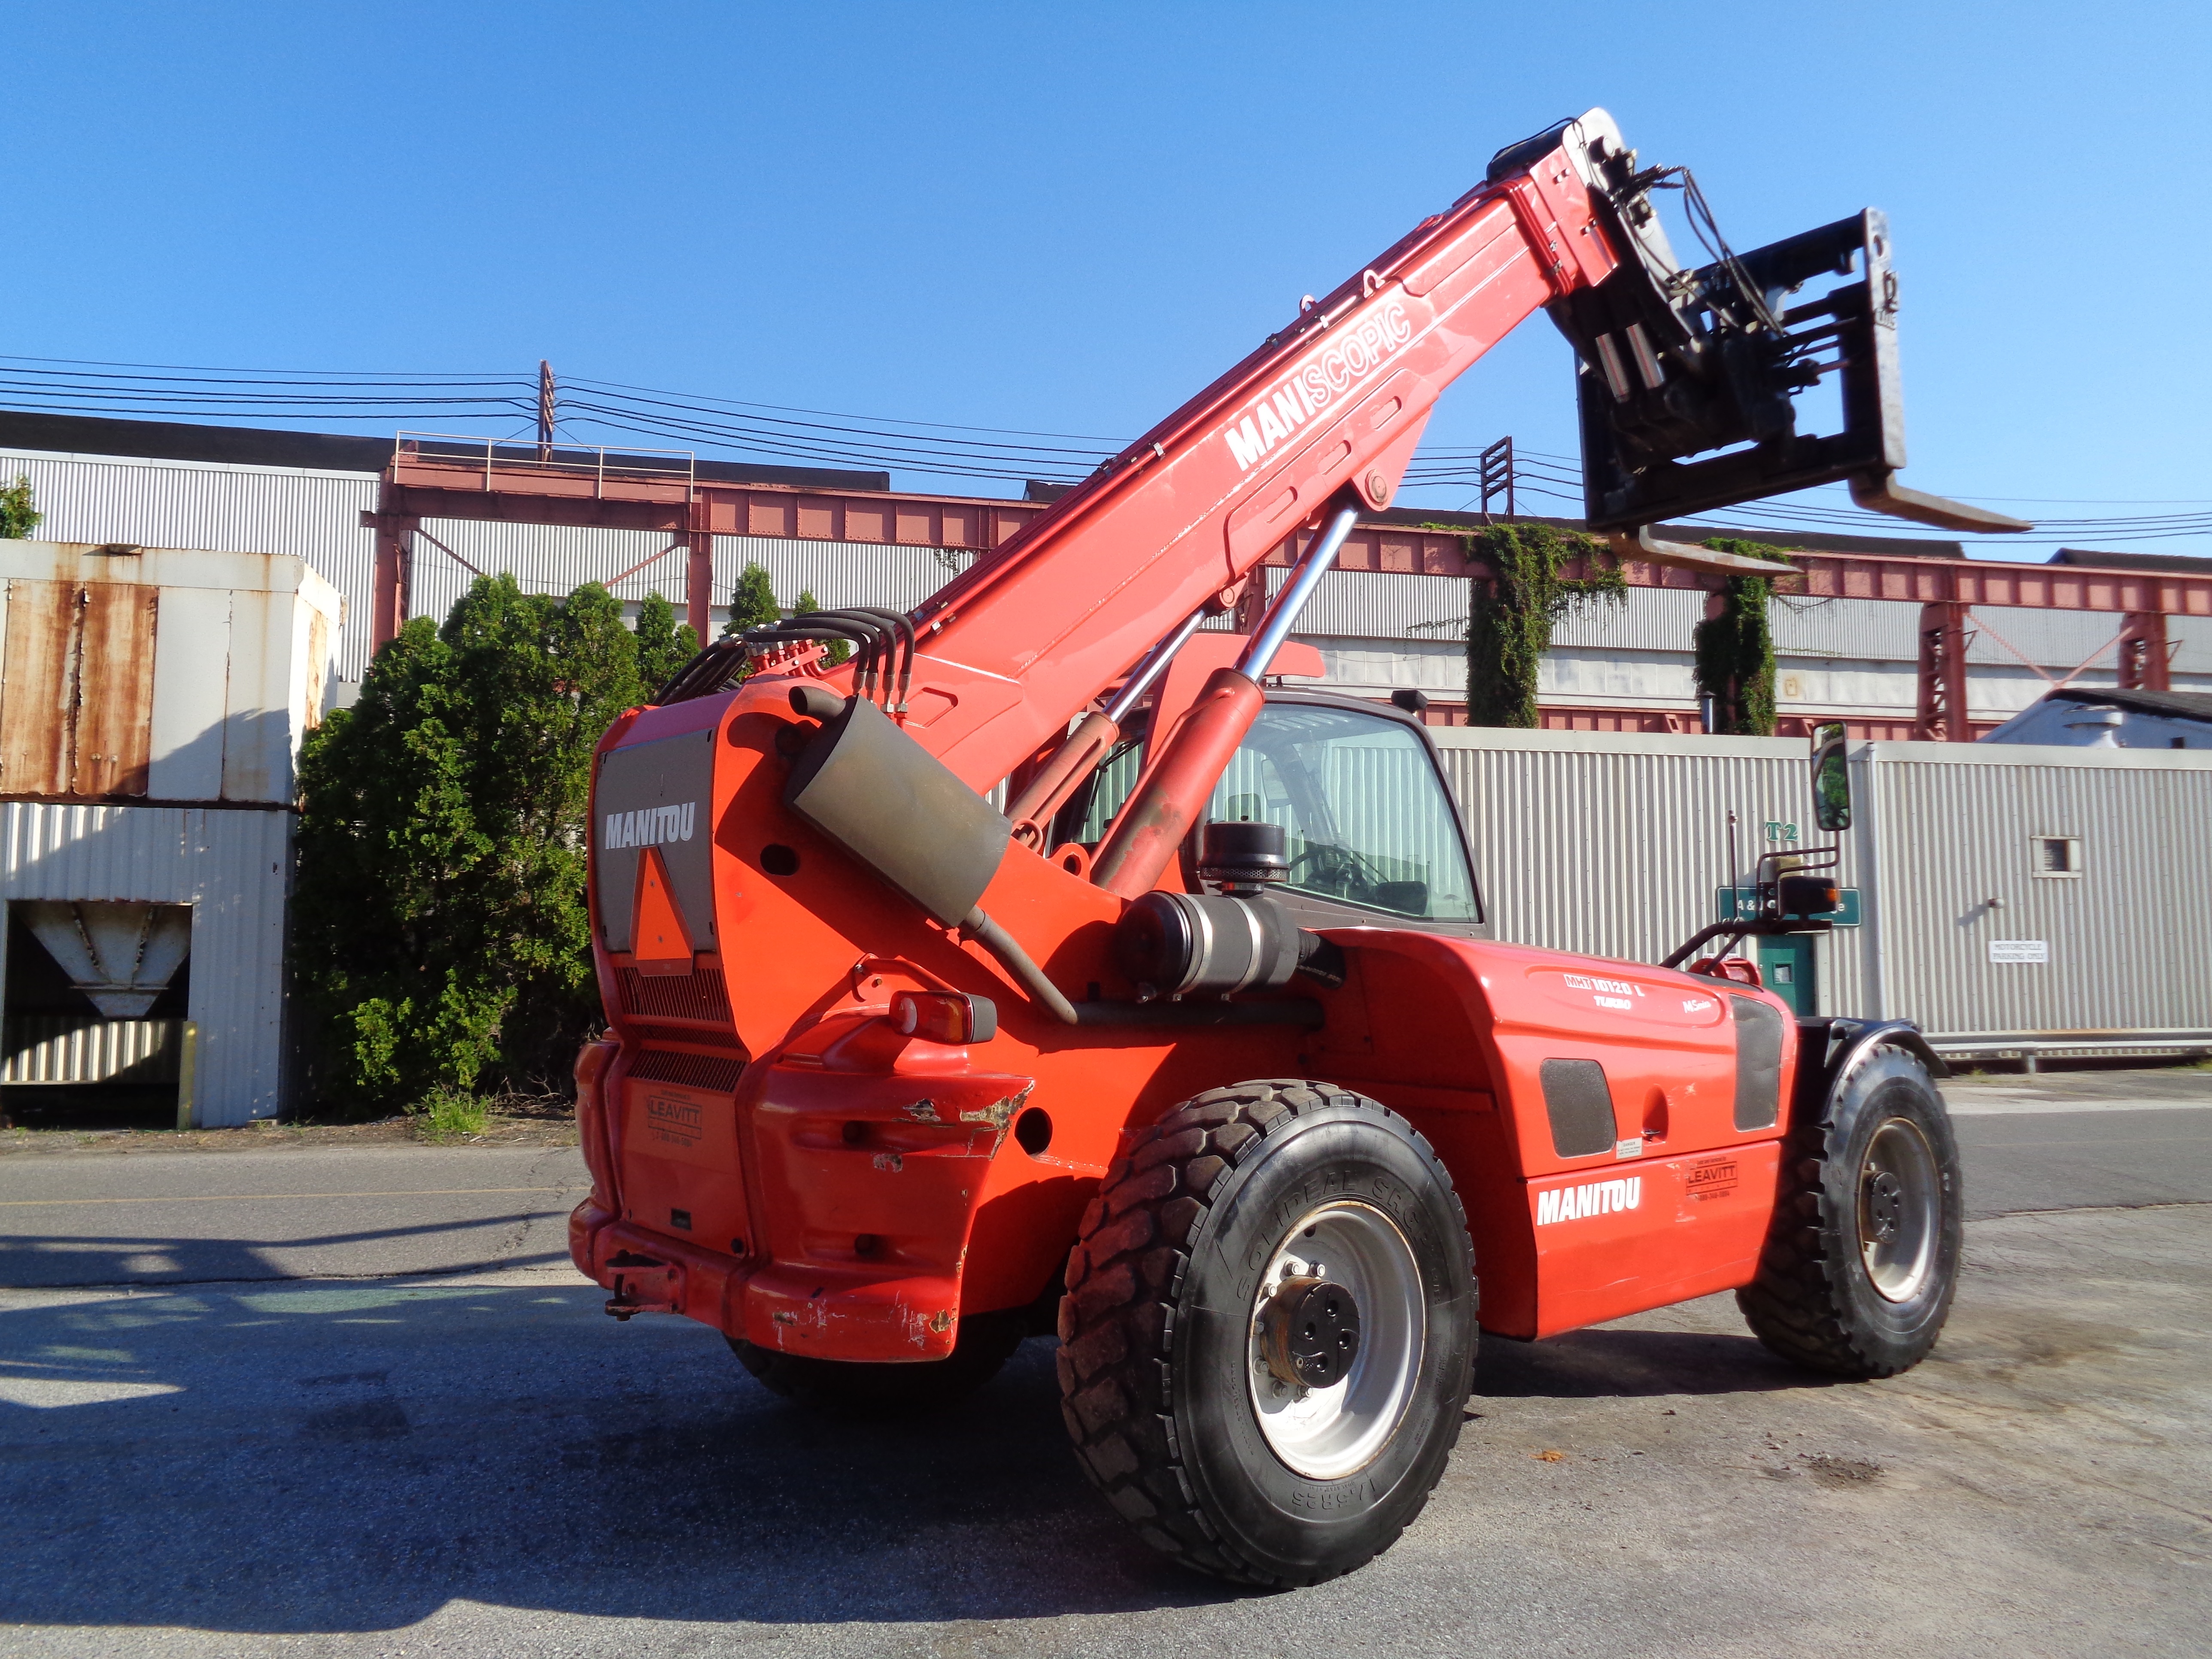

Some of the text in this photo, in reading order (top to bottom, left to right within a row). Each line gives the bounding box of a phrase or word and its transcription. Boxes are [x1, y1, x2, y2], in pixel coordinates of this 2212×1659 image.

[1223, 301, 1411, 471] MANISCOPIC
[605, 802, 695, 849] MANITOU
[1564, 974, 1645, 997] MHT 10120 L
[1593, 995, 1632, 1010] TURBO
[650, 1100, 699, 1123] LEAVITT
[1688, 1165, 1735, 1184] LEAVITT
[1537, 1176, 1641, 1226] MANITOU
